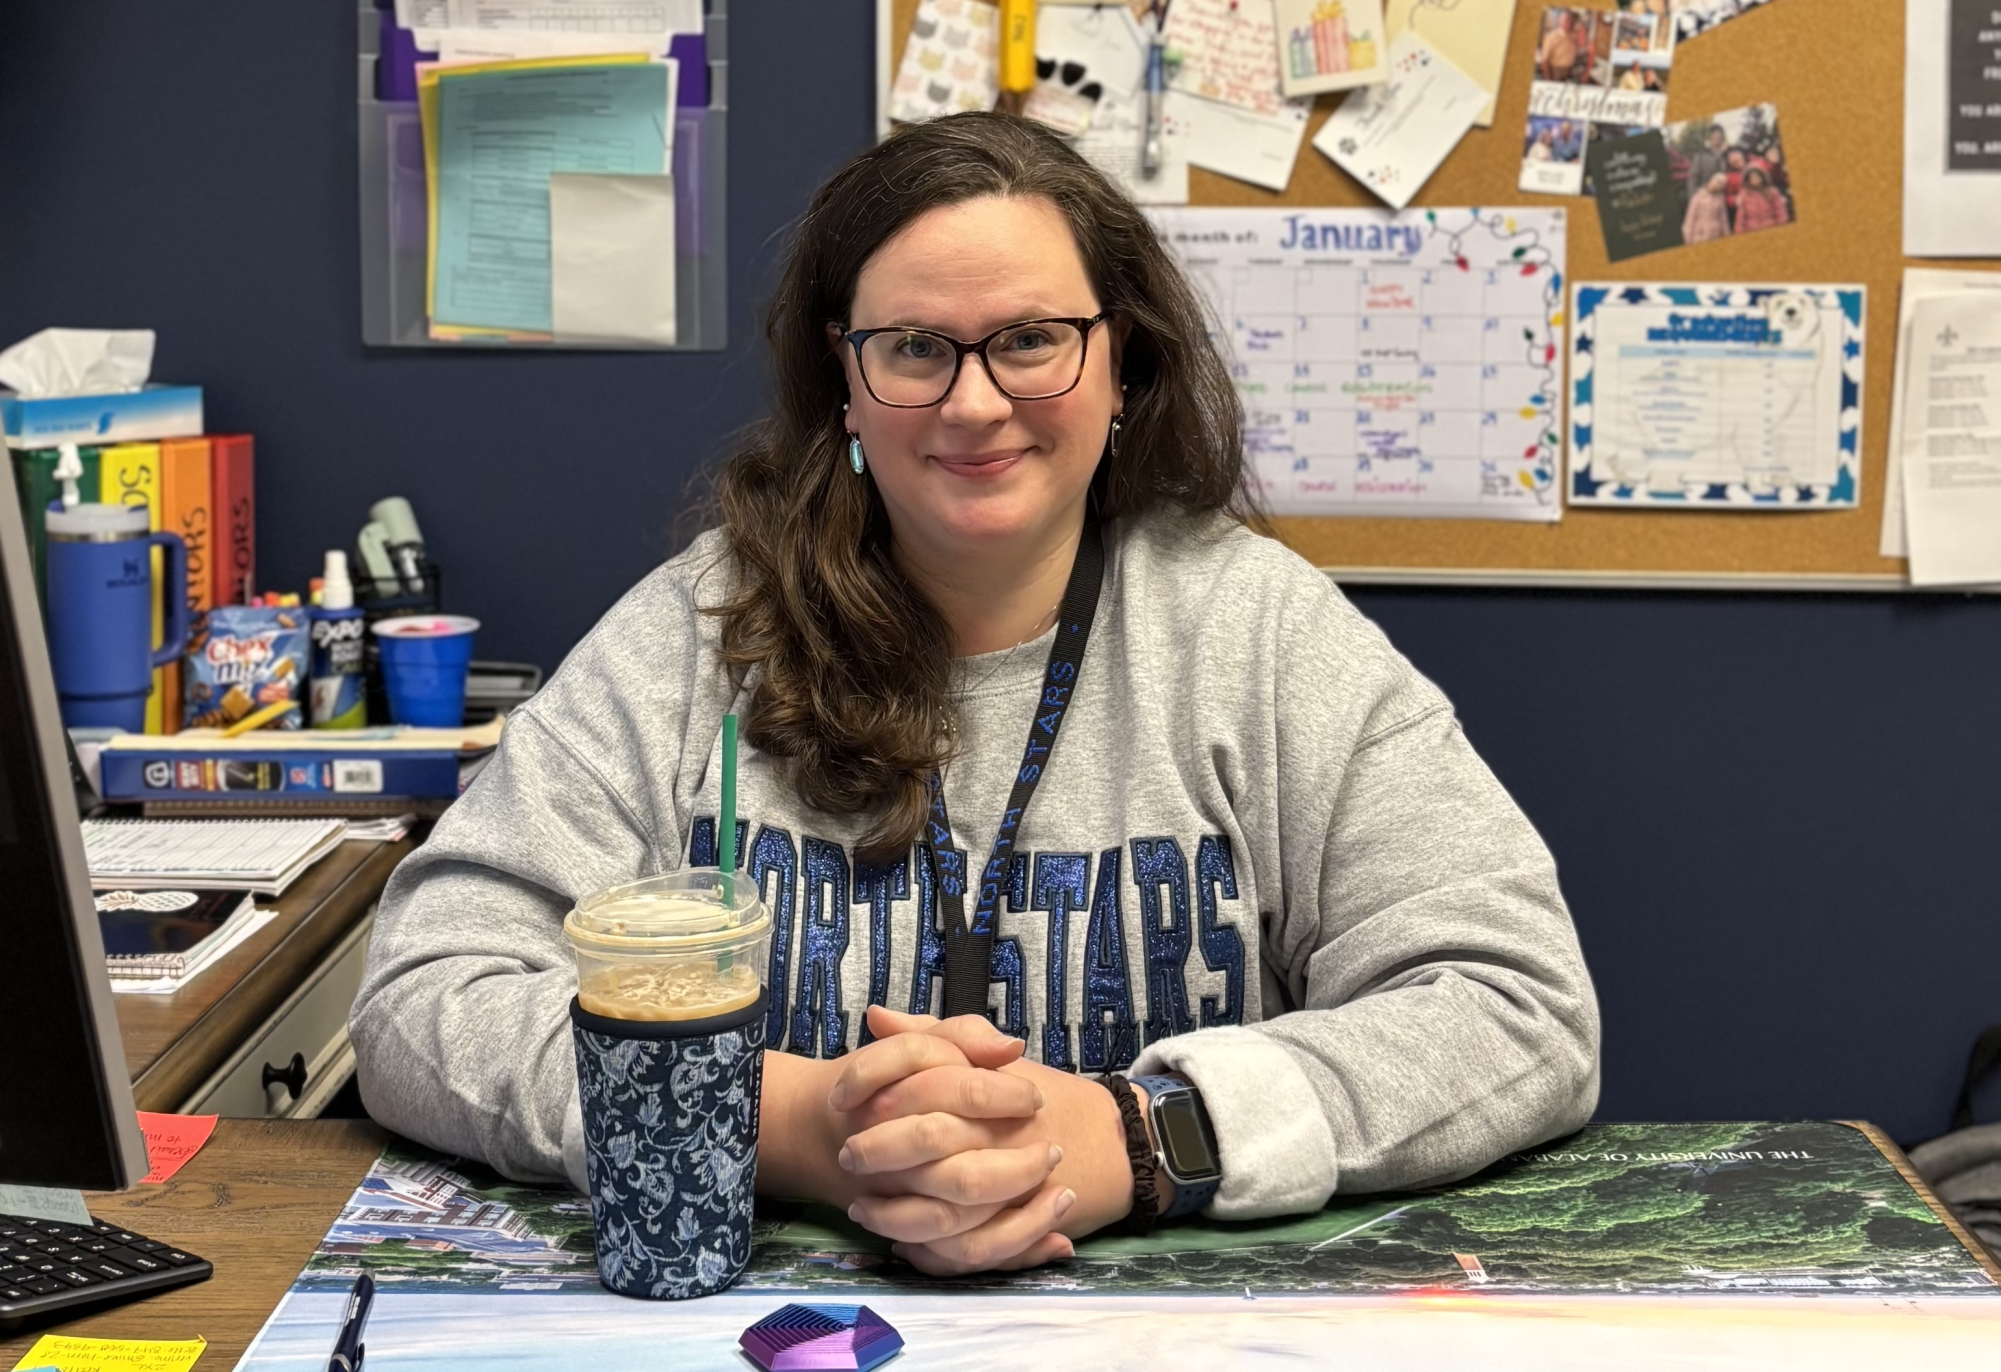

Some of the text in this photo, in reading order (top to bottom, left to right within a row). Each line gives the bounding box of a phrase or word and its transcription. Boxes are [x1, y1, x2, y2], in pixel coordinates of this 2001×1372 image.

[1280, 214, 1421, 255] January
[312, 618, 364, 649] EXPO
[973, 660, 1076, 934] NORTH STARS
[1598, 1150, 1632, 1162] OF
[1635, 1150, 1763, 1162] UNIVERSITY
[1765, 1149, 1814, 1160] THE
